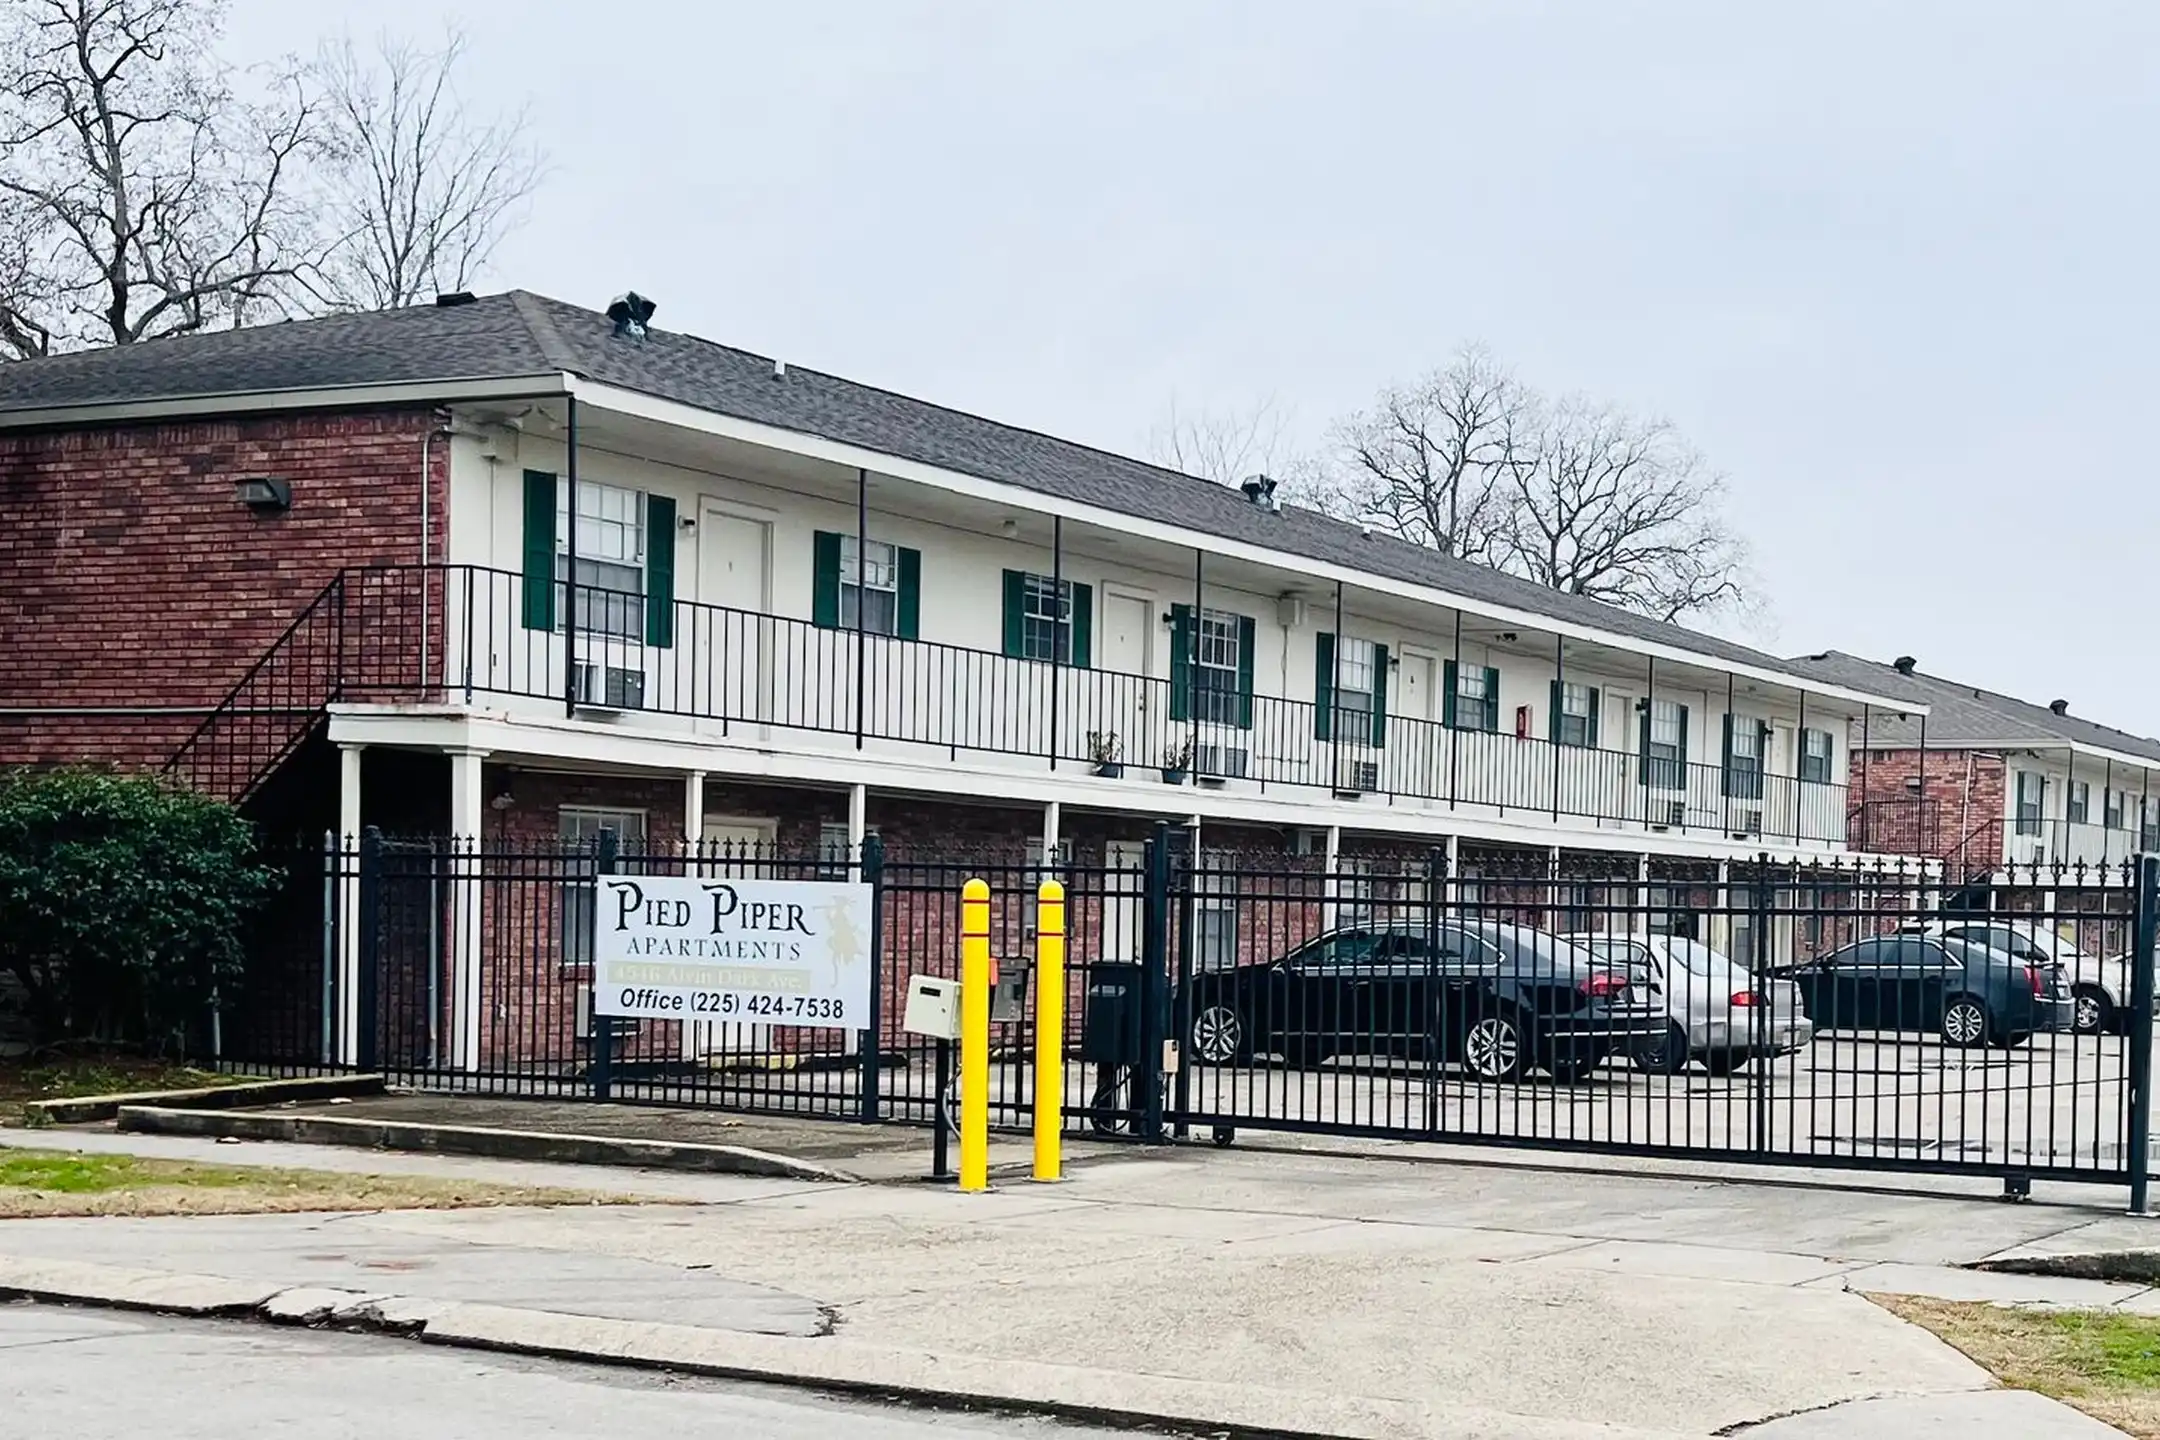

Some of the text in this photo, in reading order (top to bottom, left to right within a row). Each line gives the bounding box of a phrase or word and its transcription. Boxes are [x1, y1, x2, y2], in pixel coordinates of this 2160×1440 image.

[607, 880, 816, 936] PIED PIPER
[627, 937, 800, 960] APARTMENTS
[620, 988, 844, 1019] Office (225) 424-7538
